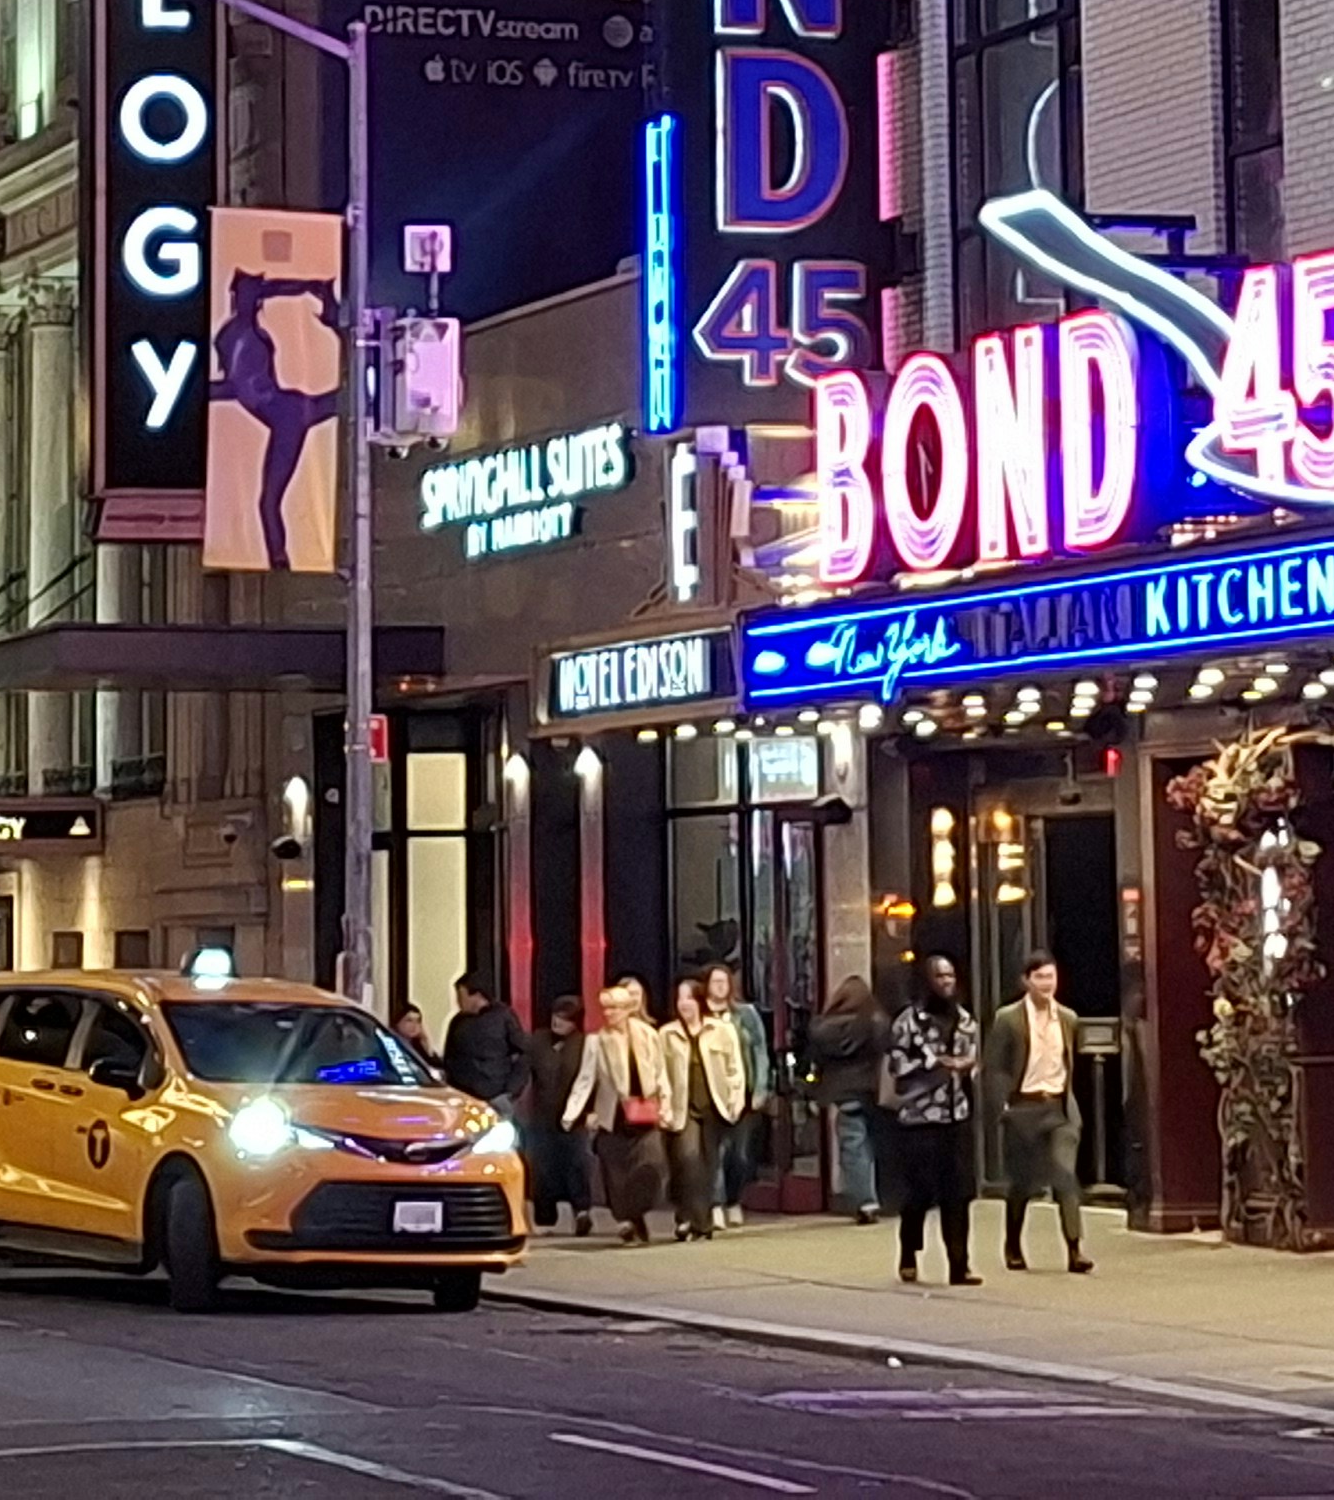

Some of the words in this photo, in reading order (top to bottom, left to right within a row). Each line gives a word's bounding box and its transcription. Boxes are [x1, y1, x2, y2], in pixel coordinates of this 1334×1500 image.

[692, 259, 869, 387] 45
[814, 306, 1139, 587] BOND
[560, 651, 622, 713] HOTEL
[624, 636, 705, 703] EDISON
